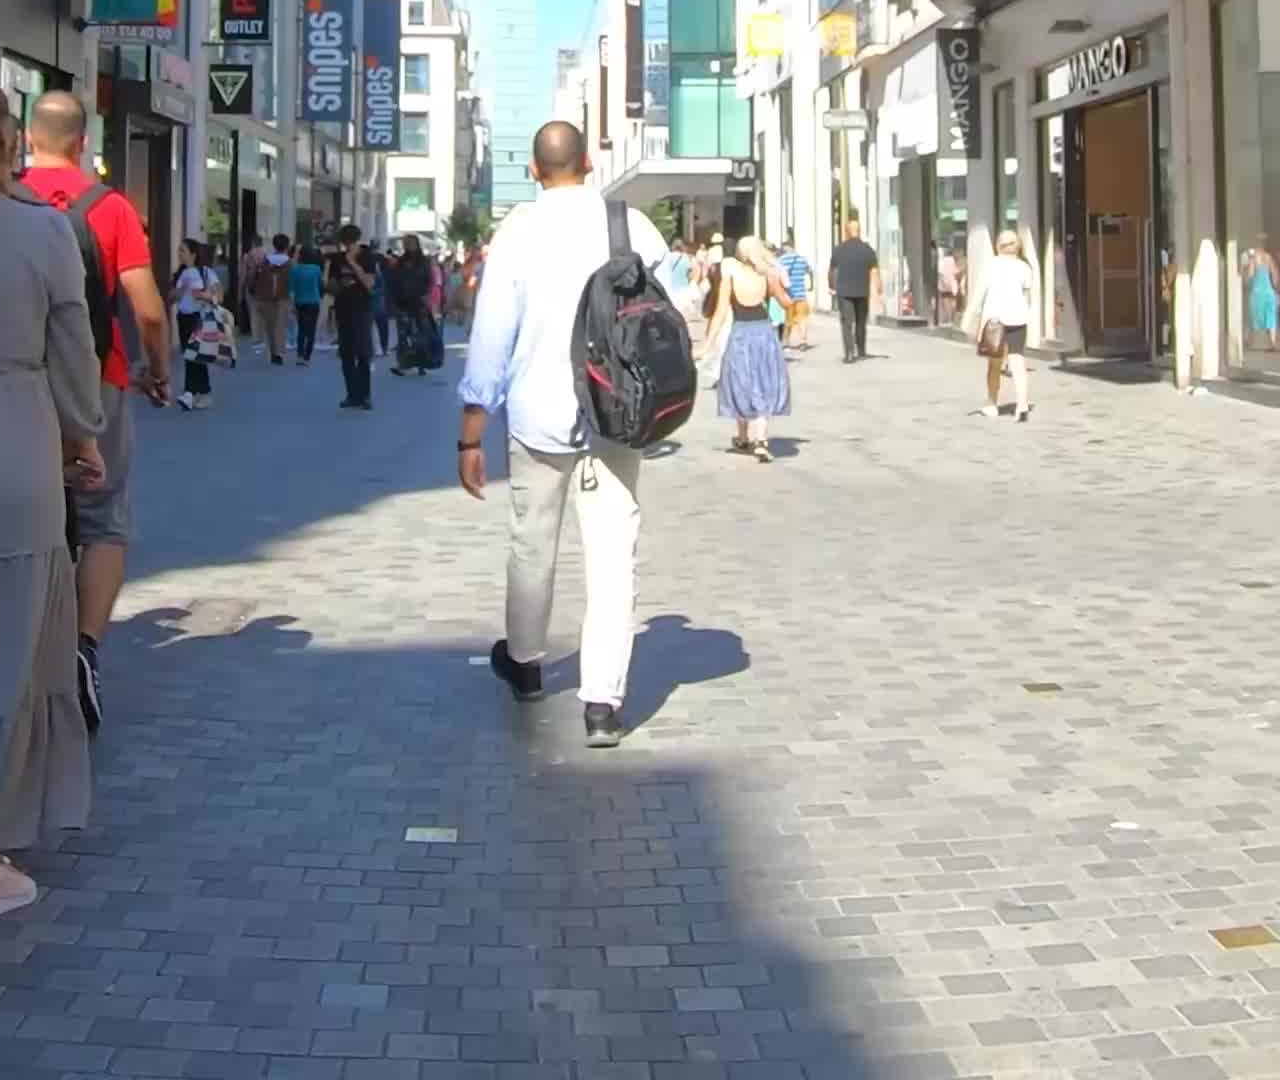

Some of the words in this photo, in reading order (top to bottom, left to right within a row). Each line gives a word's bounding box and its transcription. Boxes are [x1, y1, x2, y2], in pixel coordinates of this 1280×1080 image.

[223, 20, 265, 35] OUTLET
[308, 10, 349, 112] snipes
[366, 65, 398, 145] snipes
[949, 38, 969, 151] MANGO
